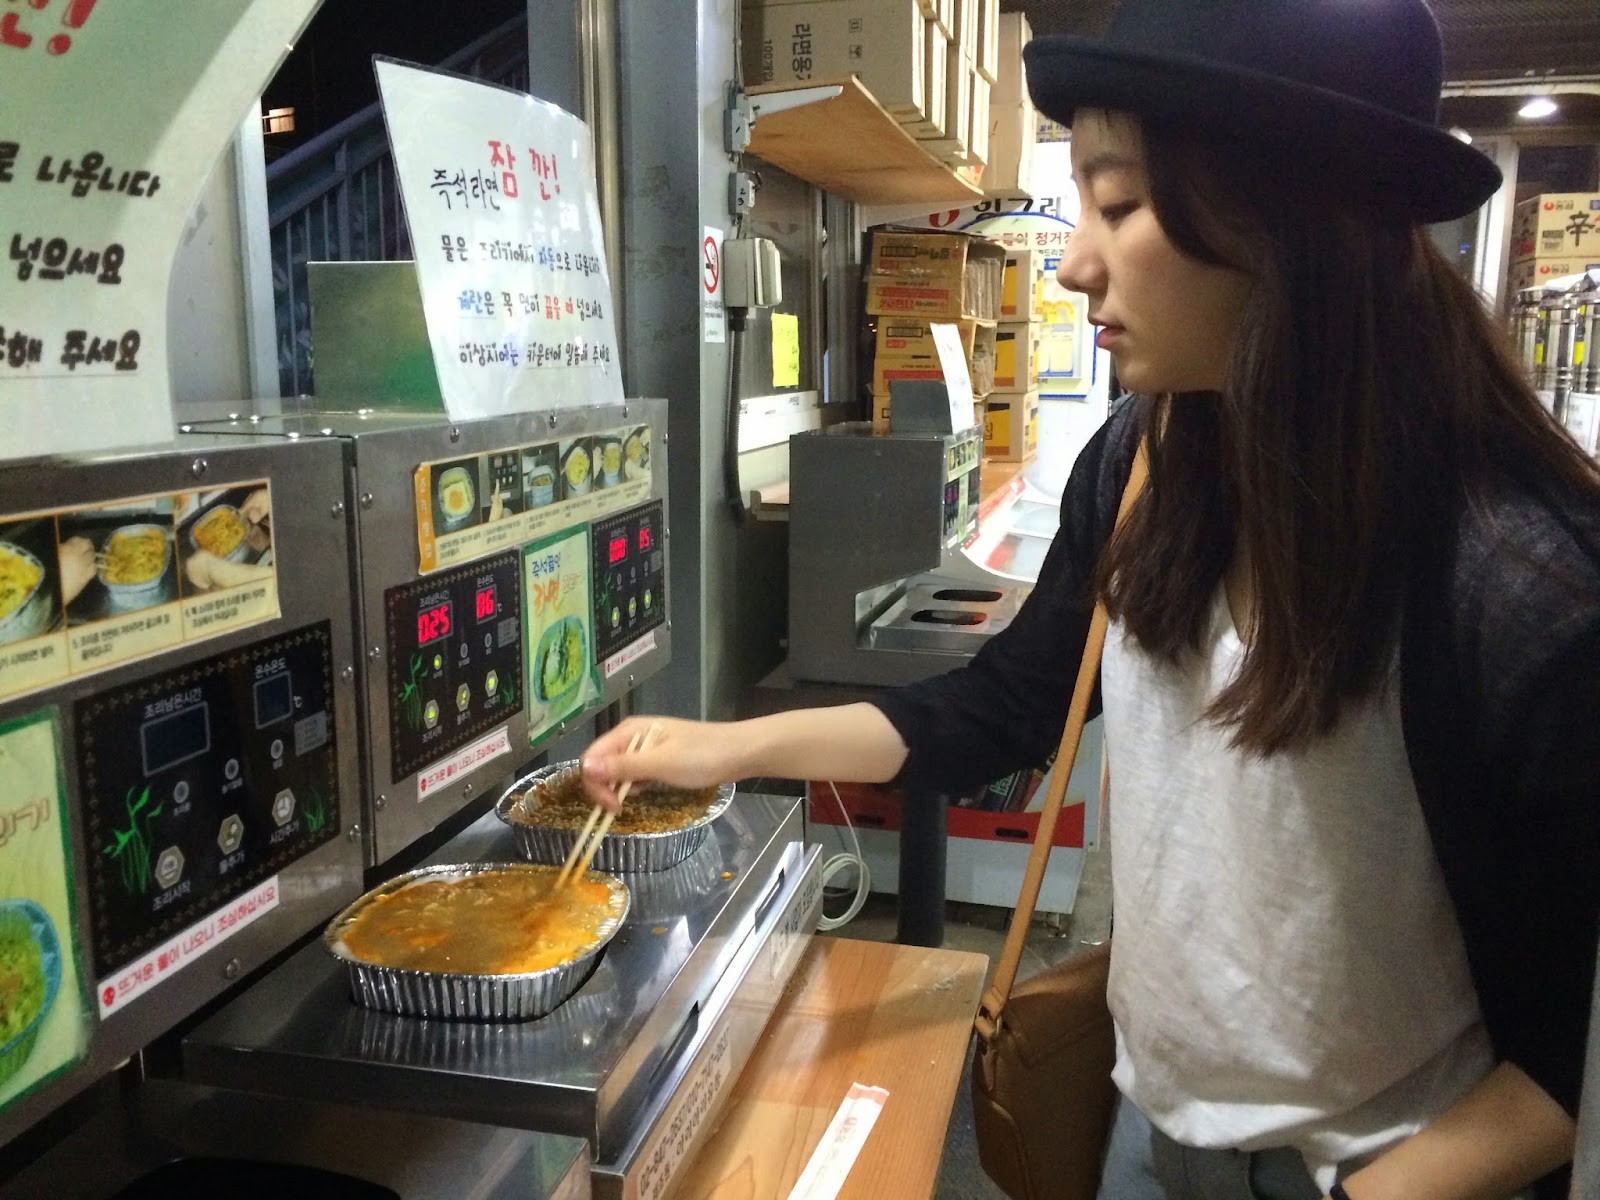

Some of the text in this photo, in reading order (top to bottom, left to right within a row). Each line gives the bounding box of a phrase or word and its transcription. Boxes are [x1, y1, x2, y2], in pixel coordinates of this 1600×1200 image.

[36, 151, 161, 198] 나옵니다
[431, 168, 501, 210] 즉석라면
[488, 140, 560, 201] 잠 깐!
[9, 233, 125, 284] 넣으세요
[441, 234, 468, 262] 물은
[0, 325, 140, 371] 해 주세요
[255, 657, 287, 679] 온수온도
[118, 962, 154, 997] 뜨거운
[183, 922, 215, 955] 나오니
[217, 886, 275, 933] 조심하십시오
